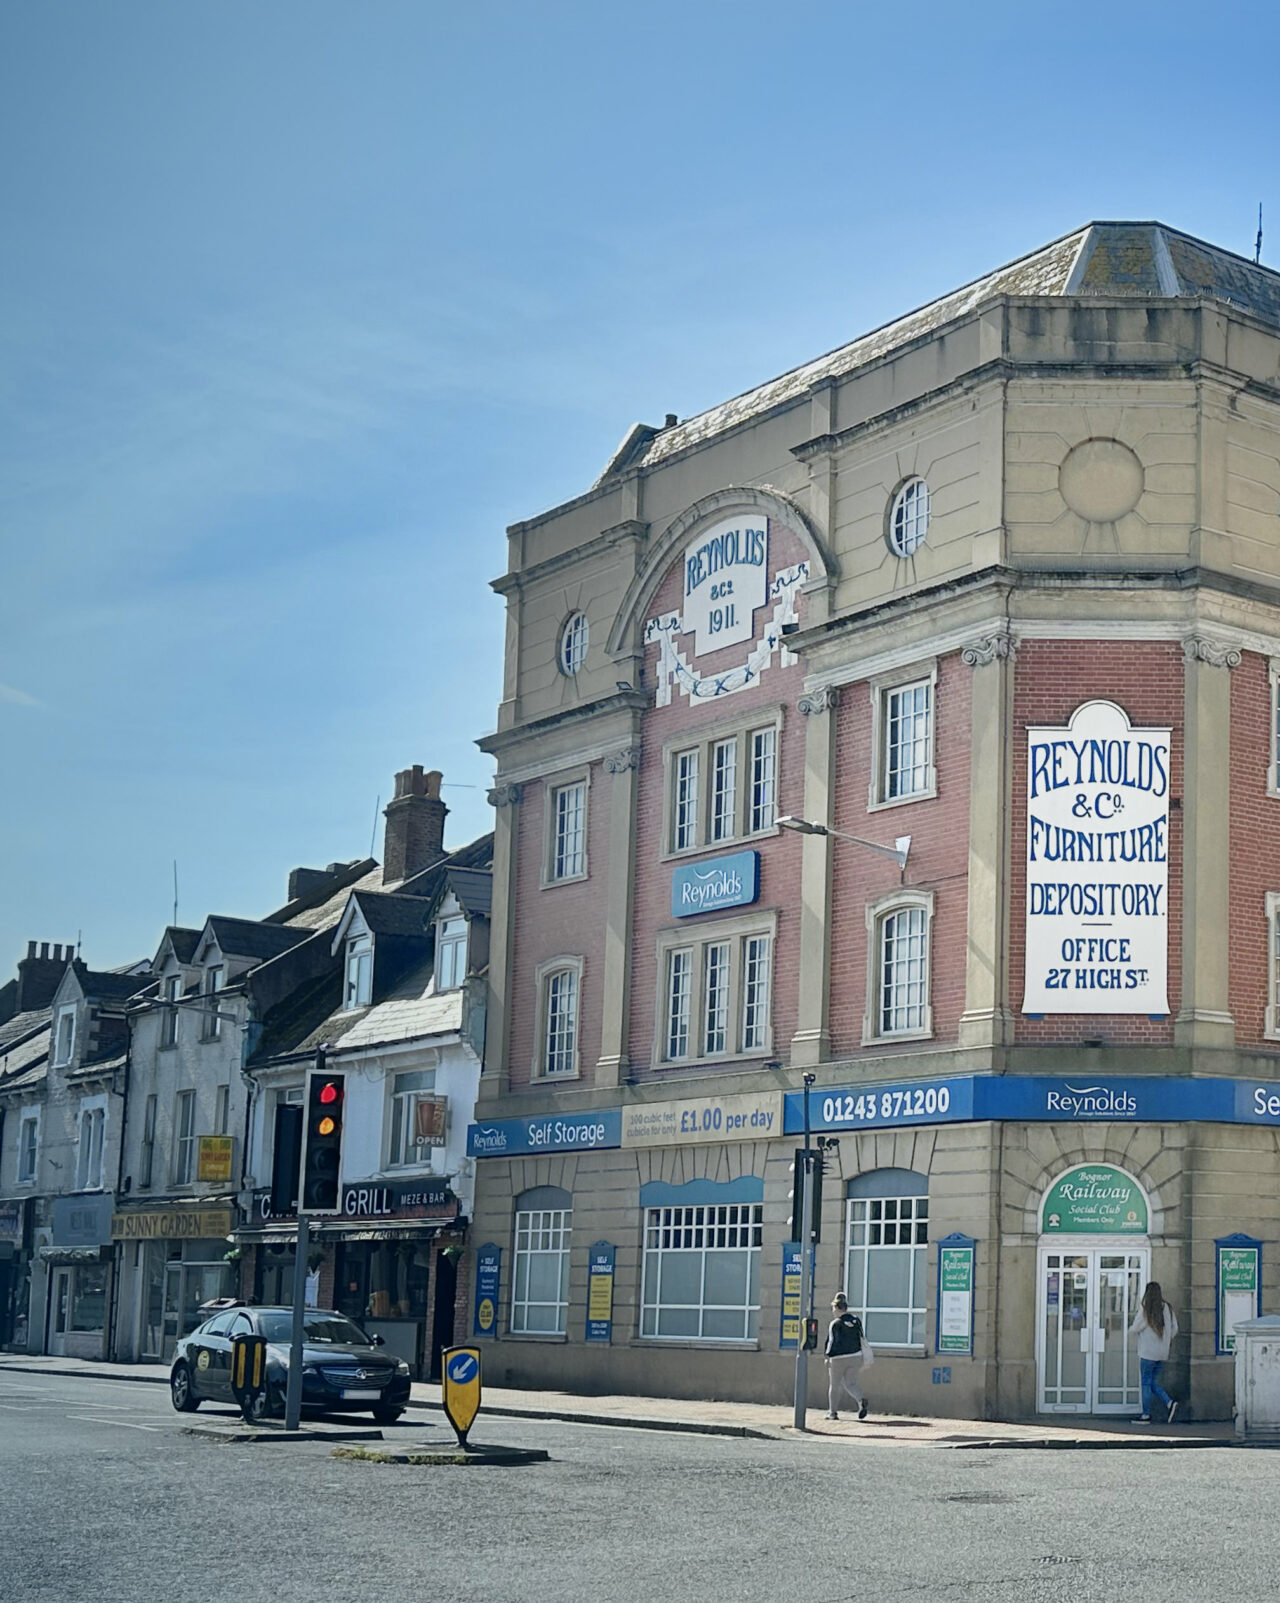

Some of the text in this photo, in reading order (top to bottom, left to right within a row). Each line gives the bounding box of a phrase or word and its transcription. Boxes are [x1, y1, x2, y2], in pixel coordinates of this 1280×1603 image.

[686, 529, 765, 597] REYNOLDS
[1030, 739, 1168, 799] REYNOLDS
[1029, 814, 1167, 863] FURNITURE
[682, 869, 742, 908] Reynolds
[1061, 938, 1132, 963] OFFICE
[1045, 969, 1071, 989] 27
[1075, 969, 1122, 989] HIGH
[823, 1087, 950, 1122] 01243 871200
[1047, 1090, 1137, 1117] Reynolds
[630, 1111, 676, 1125] 100 cubic feet
[651, 1125, 661, 1135] for
[661, 1124, 677, 1136] only
[680, 1107, 774, 1133] £1.00 per day
[416, 1136, 444, 1145] OPEN
[473, 1130, 507, 1151] Reynolds
[528, 1121, 604, 1147] Self Storage
[1078, 1171, 1112, 1183] Bognor
[345, 1188, 391, 1215] GRILL
[401, 1193, 421, 1205] MEZE
[422, 1193, 428, 1204] &
[429, 1192, 445, 1203] BAR
[1059, 1183, 1131, 1204] Railway
[1069, 1203, 1121, 1215] Social Club
[126, 1215, 158, 1236] SUNNY
[160, 1213, 201, 1236] GARDEN
